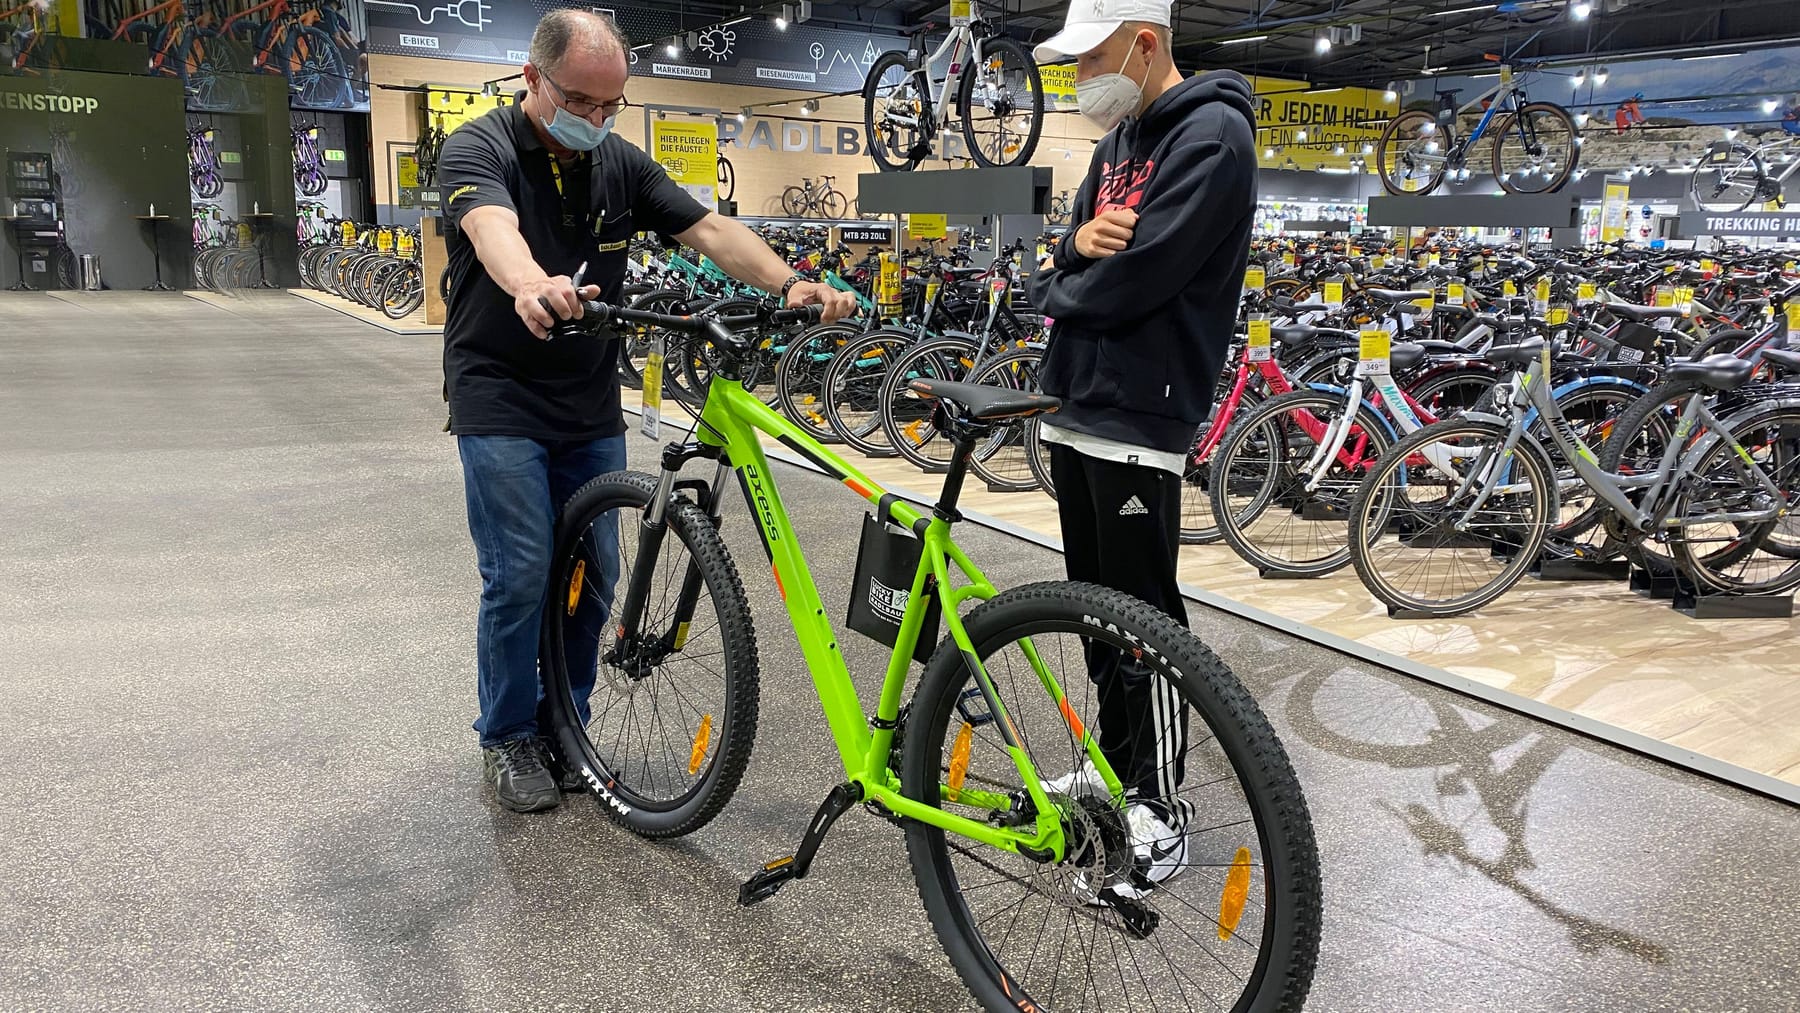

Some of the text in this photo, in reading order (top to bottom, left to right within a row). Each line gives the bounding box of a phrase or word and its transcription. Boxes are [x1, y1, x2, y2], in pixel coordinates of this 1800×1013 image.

[403, 36, 436, 47] E-BIKES
[656, 66, 708, 77] MARKENRÄDER
[760, 70, 812, 81] RIESENAUSWAHL
[1040, 68, 1075, 79] NFACH DAS
[1041, 79, 1063, 87] HTIGE
[1279, 100, 1337, 126] JEDEM
[1343, 106, 1388, 130] HELM
[661, 135, 710, 145] HIER FLIEGEN
[1270, 128, 1293, 148] EIN
[675, 144, 703, 153] FÄUSTE
[1706, 217, 1780, 231] TREKKING
[844, 231, 886, 240] MTB 29 ZOLL
[746, 464, 780, 541] axess
[1119, 507, 1149, 516] adidas
[872, 581, 892, 596] LUCKY
[872, 586, 891, 604] BIKE
[1083, 614, 1184, 679] MAXXIS
[581, 765, 632, 816] MAXXIS
